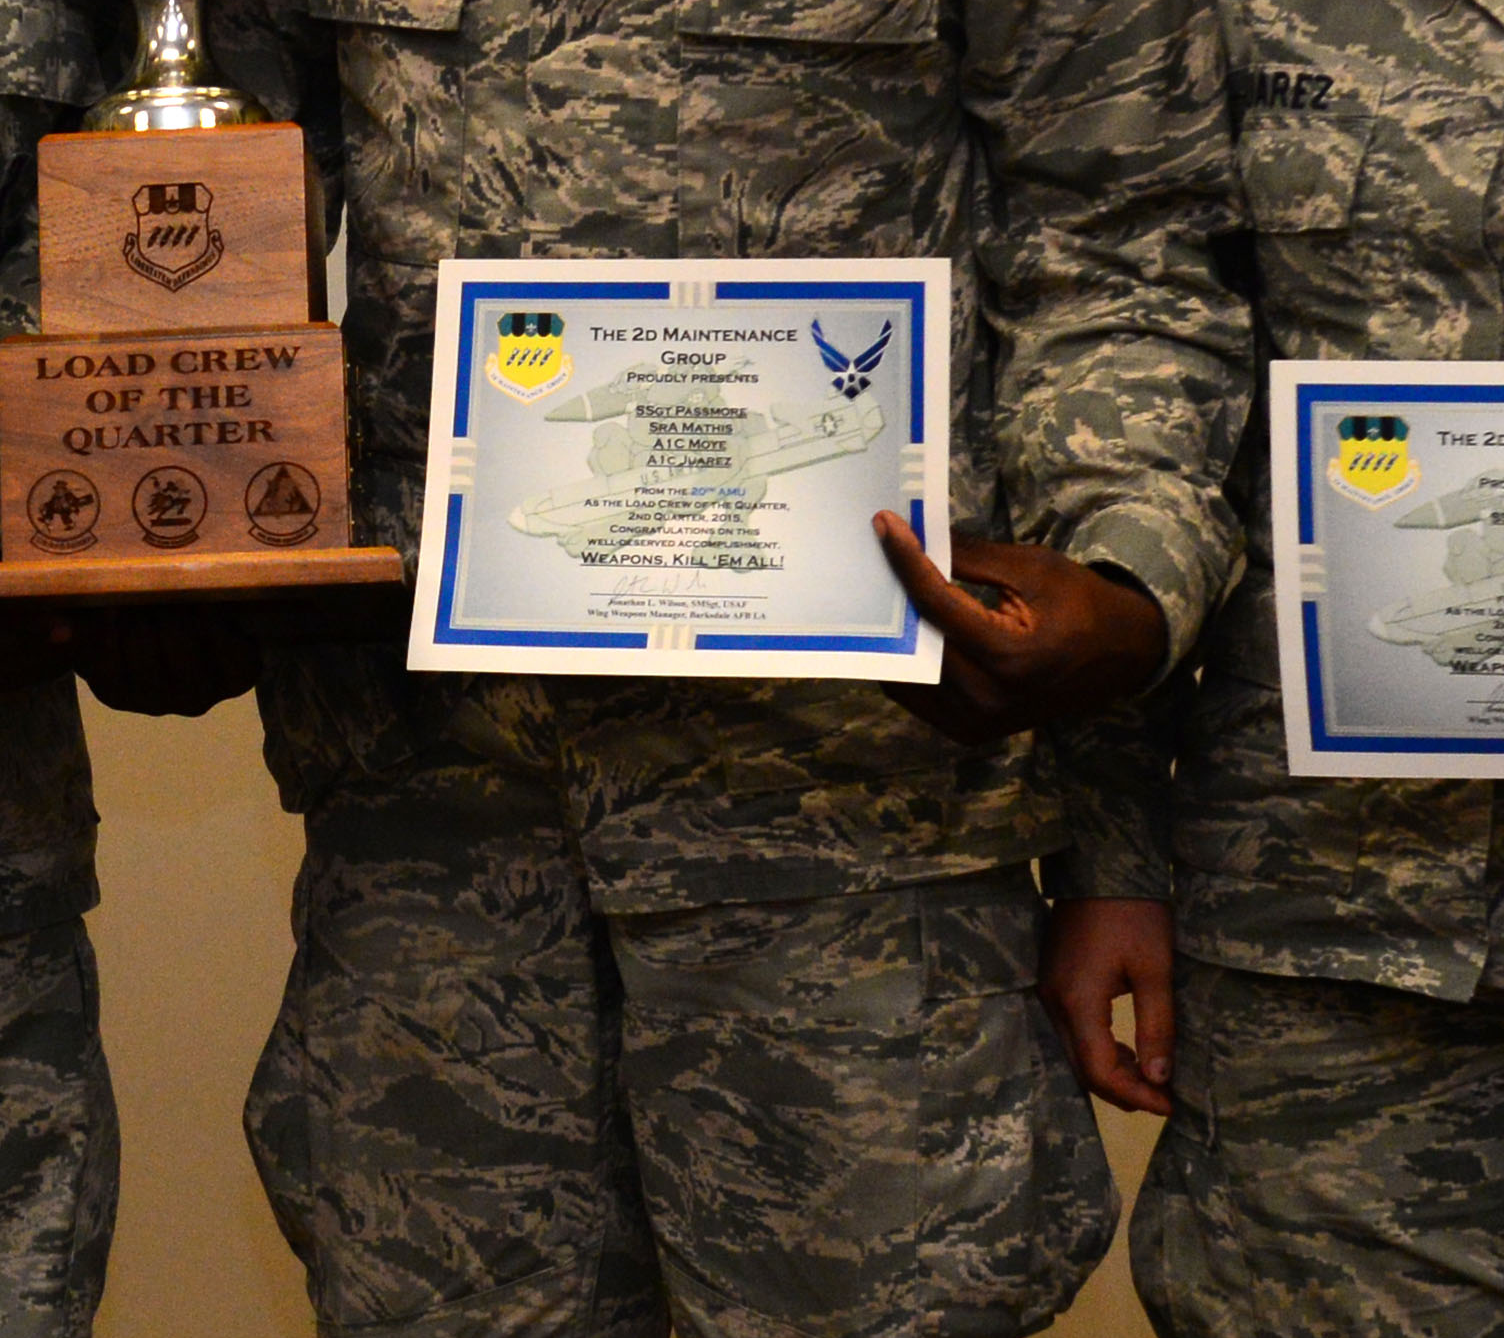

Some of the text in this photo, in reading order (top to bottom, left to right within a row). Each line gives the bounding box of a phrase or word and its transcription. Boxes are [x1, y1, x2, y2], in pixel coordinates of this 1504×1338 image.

[590, 327, 627, 341] THE
[663, 328, 798, 341] MAINTENANCE
[36, 346, 301, 380] LOAD CREW
[661, 351, 726, 365] GROUP
[627, 373, 759, 383] PROUDLY PRESENTS
[85, 384, 252, 414] OF THE
[62, 420, 277, 456] QUARTER
[654, 439, 727, 449] A1C MOYE
[1437, 431, 1477, 446] THE
[647, 456, 732, 466] A1C JUAREZ
[609, 525, 715, 535] CONGRATULATIONS
[580, 552, 668, 566] WEAPONS,
[672, 553, 709, 566] KILL
[747, 556, 783, 567] ALL!
